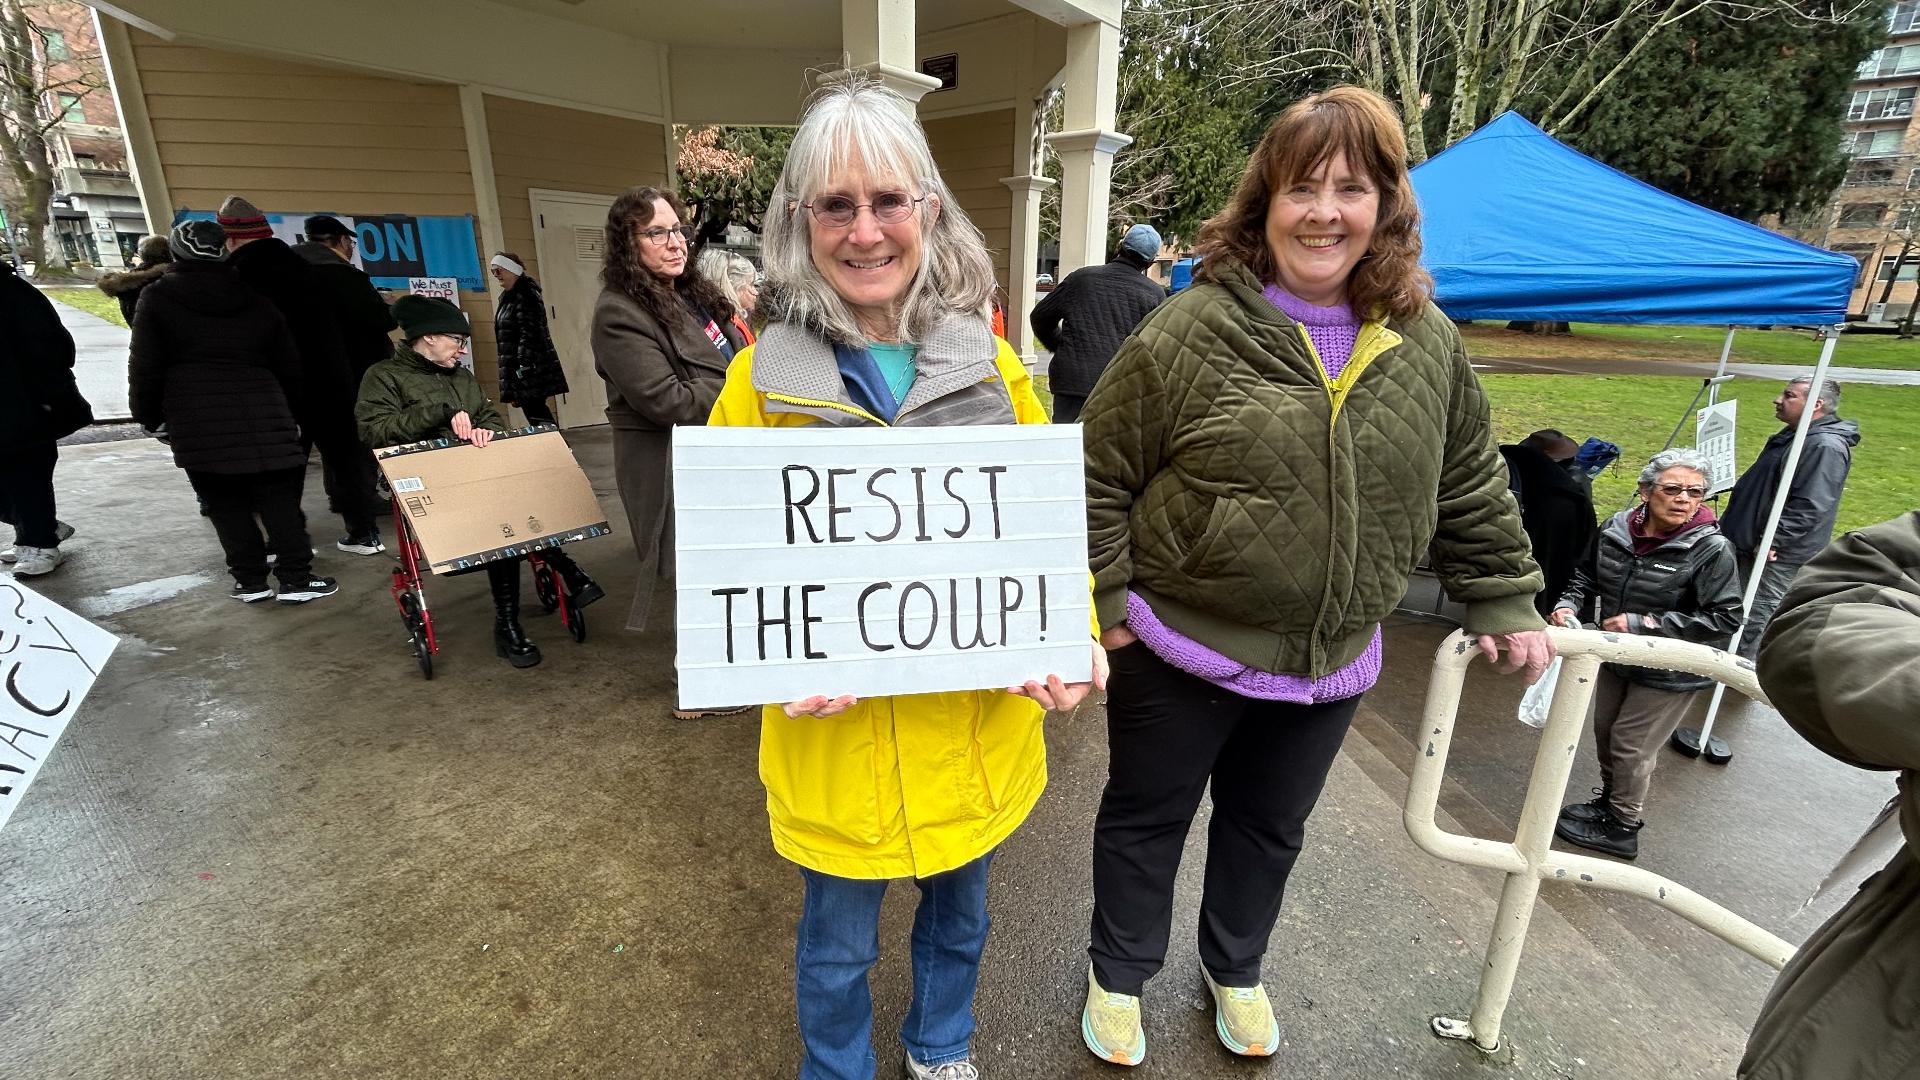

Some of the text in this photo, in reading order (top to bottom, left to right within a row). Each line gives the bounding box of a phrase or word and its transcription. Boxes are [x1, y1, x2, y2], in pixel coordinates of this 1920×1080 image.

[411, 278, 452, 289] We Must
[782, 465, 1006, 544] RESIST
[712, 575, 1047, 663] THE COUP!
